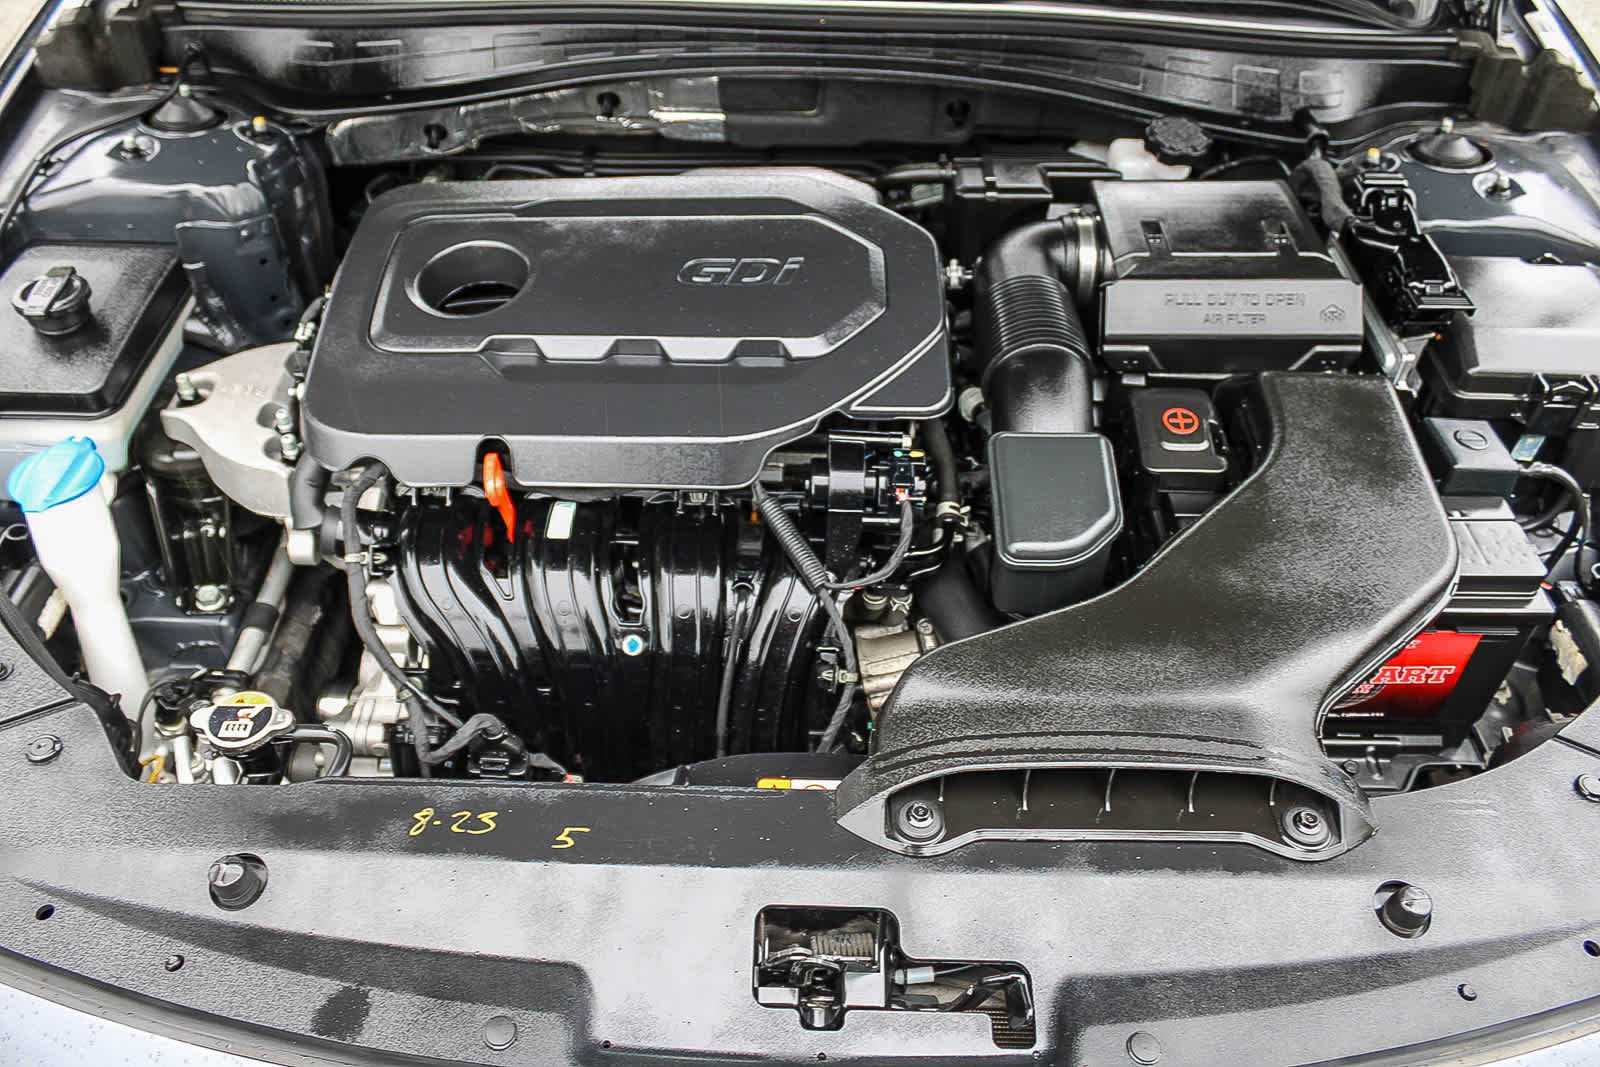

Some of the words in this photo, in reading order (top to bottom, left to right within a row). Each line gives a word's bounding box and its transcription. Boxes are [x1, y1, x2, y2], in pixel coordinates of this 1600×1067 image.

[1164, 292, 1203, 306] PULL
[1207, 292, 1238, 306] OUT
[1240, 292, 1261, 306] TO
[1265, 292, 1306, 306] OPEN
[1203, 312, 1224, 325] AIR
[1226, 312, 1267, 325] FILTER
[408, 807, 499, 836] 8-23
[551, 826, 592, 849] 5
